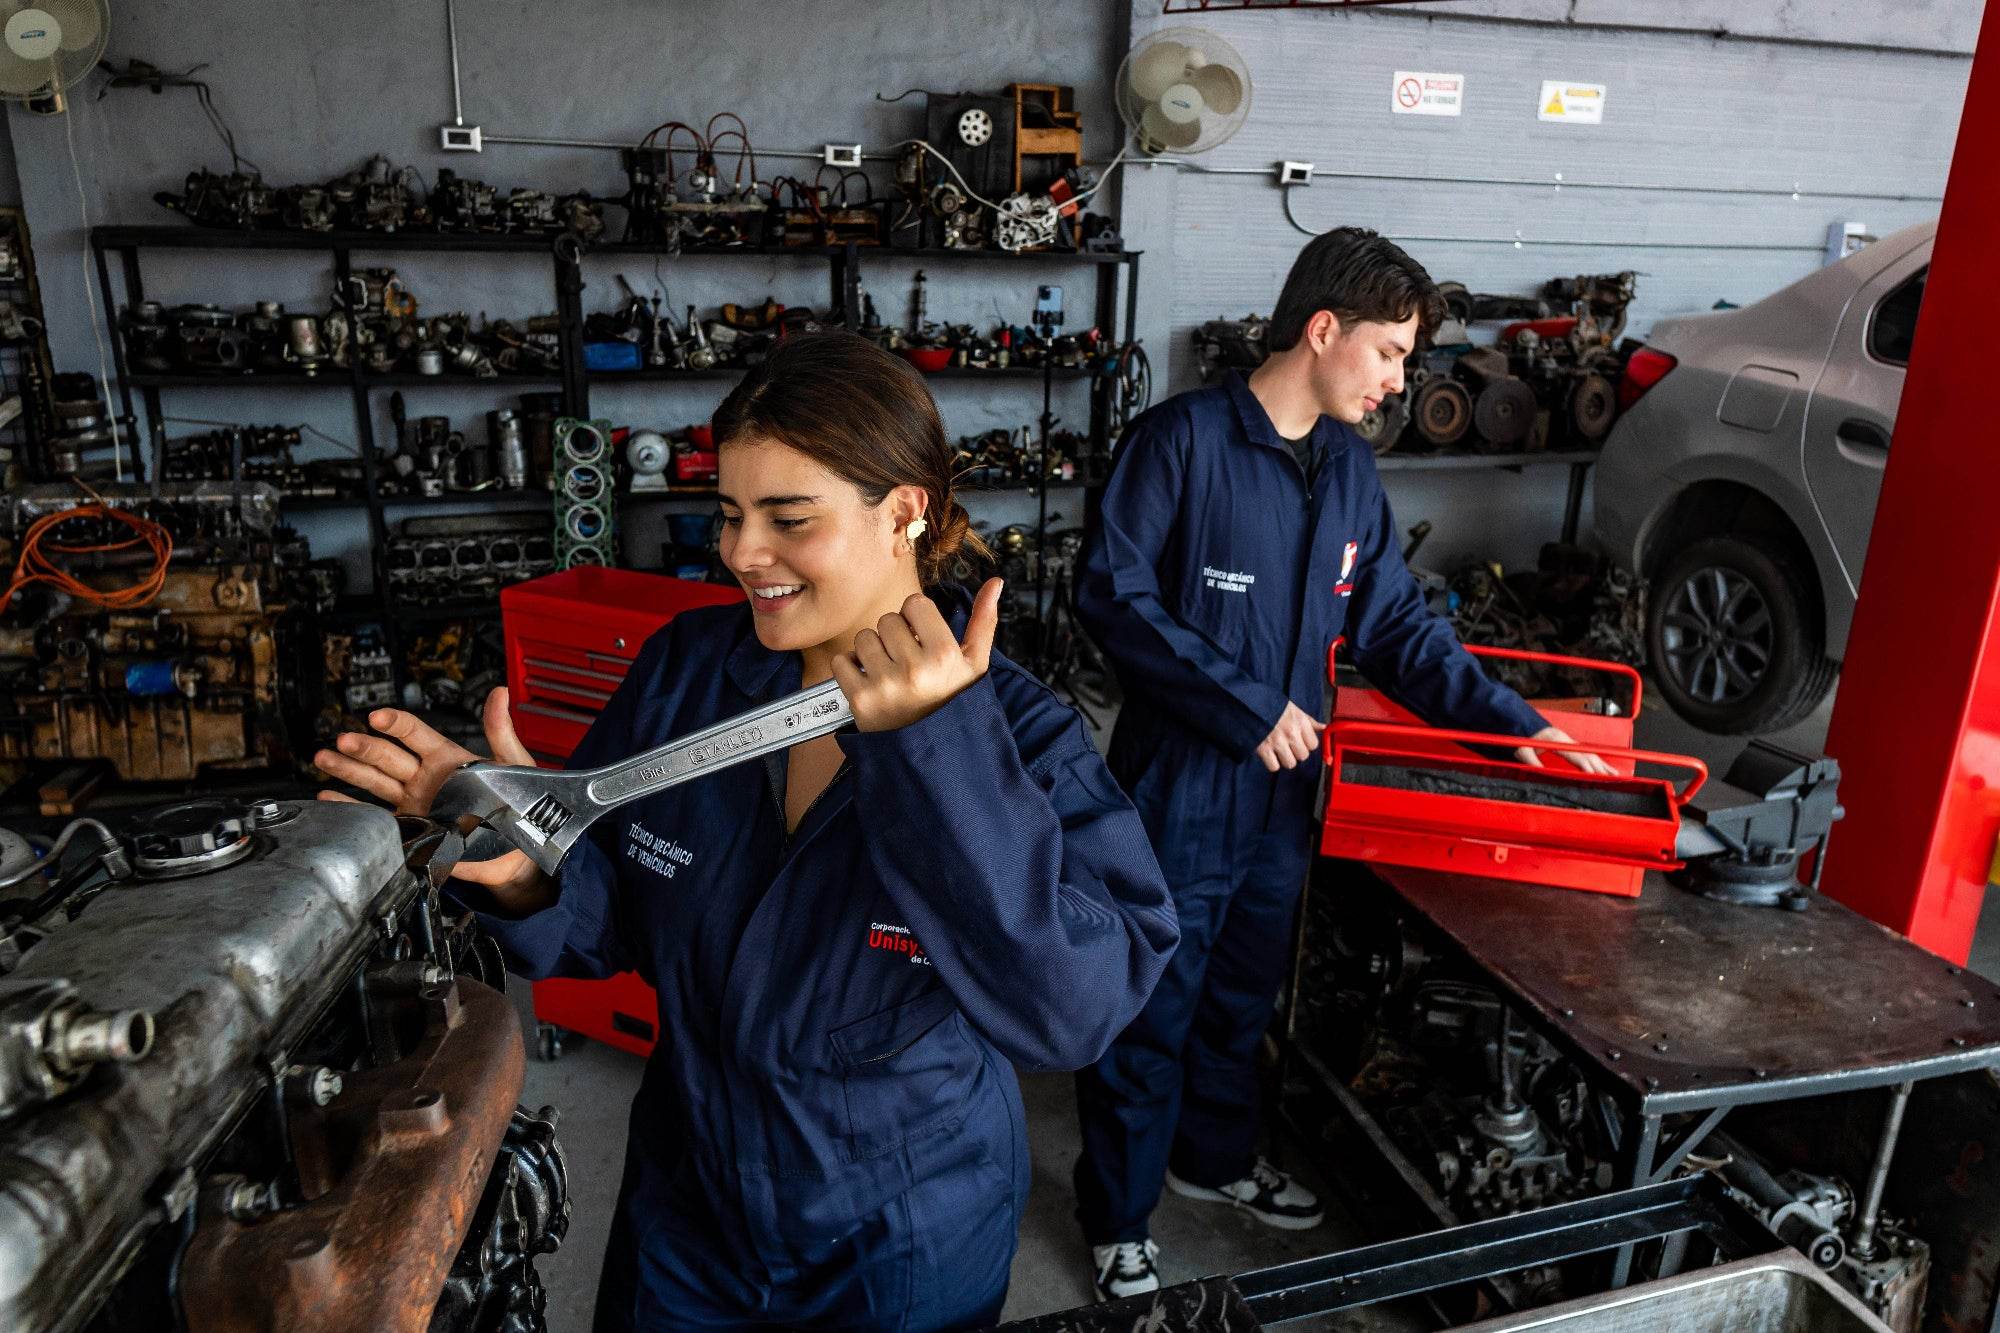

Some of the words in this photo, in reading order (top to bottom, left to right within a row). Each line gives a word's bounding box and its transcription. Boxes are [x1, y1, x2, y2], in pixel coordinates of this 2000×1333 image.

[694, 727, 762, 763] STANLEY
[628, 821, 654, 847] TÉCNICO
[652, 836, 693, 866] MECÁNICO
[627, 843, 638, 858] DE
[638, 848, 676, 879] VEHÍCULOS
[869, 930, 924, 957] Unisy
[871, 922, 911, 934] Corporaci
[911, 955, 922, 963] de
